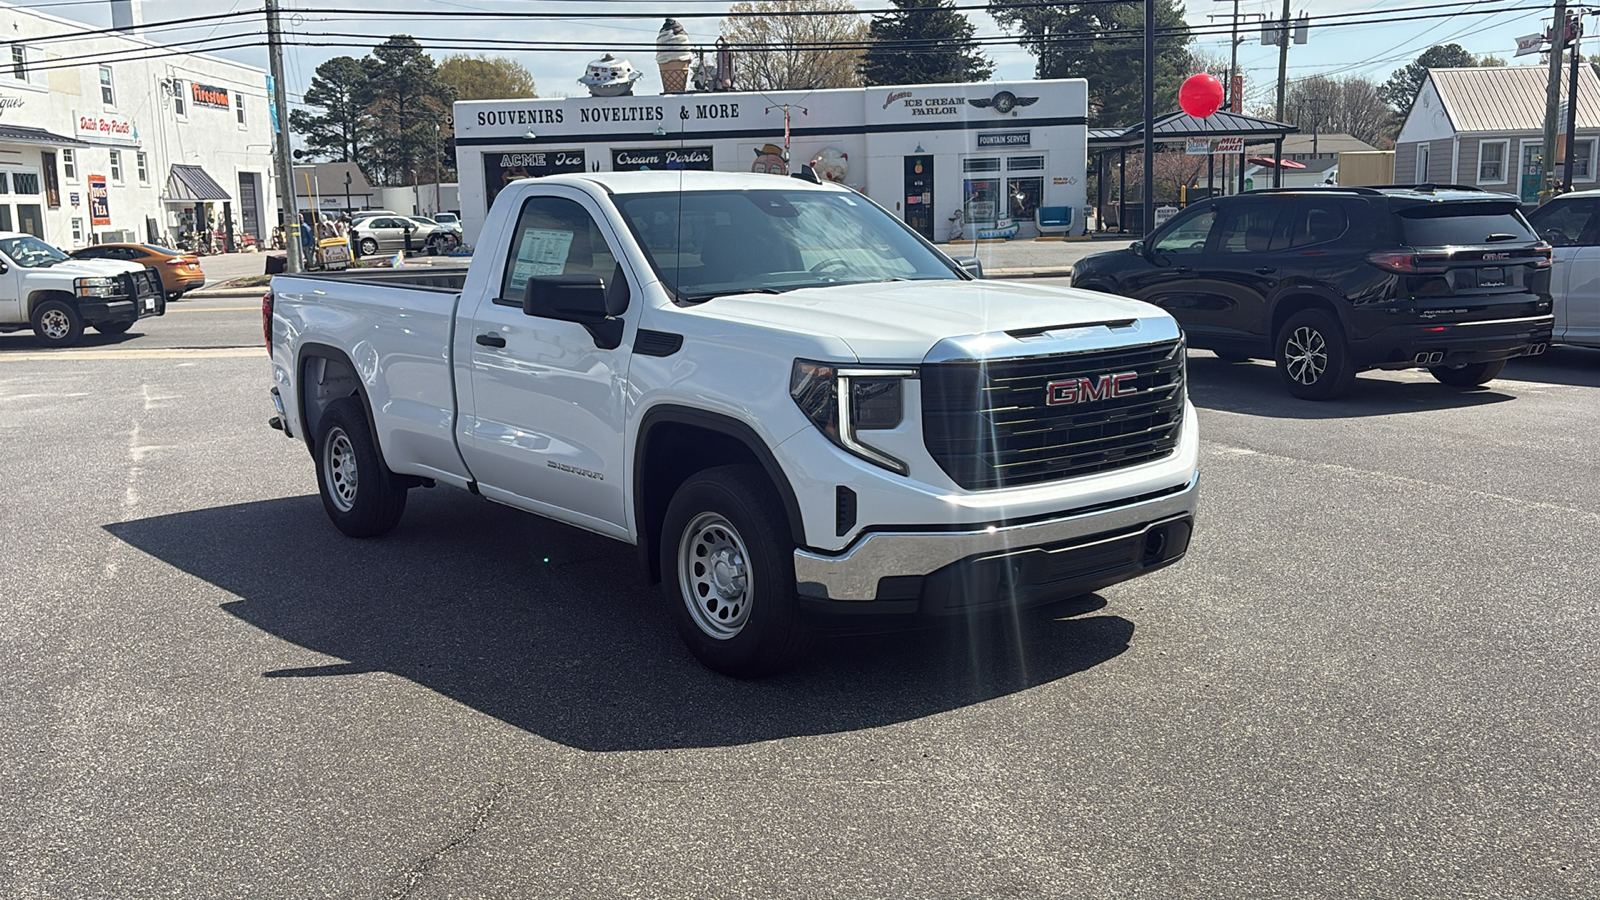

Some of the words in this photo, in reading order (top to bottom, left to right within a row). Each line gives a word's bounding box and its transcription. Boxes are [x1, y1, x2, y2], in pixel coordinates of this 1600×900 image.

[191, 83, 229, 106] Firestone
[904, 98, 923, 107] ICE
[925, 97, 966, 107] CREAM
[477, 108, 564, 127] SOUVENIRS
[580, 106, 664, 123] NOVELTIES
[679, 105, 690, 120] &
[696, 104, 740, 119] MORE
[912, 107, 958, 116] PARLOR
[80, 116, 97, 131] Dutch
[99, 118, 111, 135] Boy
[111, 120, 130, 134] Paints
[979, 135, 1006, 144] FOUNTAIN
[1006, 134, 1029, 143] SERVICE
[1214, 144, 1243, 152] SHAKES
[500, 153, 546, 167] ACME
[555, 152, 582, 166] Ice
[616, 151, 660, 165] Cream
[665, 150, 711, 163] Parlor
[94, 202, 108, 216] TEA
[1482, 252, 1510, 261] GMC
[1046, 370, 1138, 406] GMC
[546, 460, 604, 480] SIERRA
